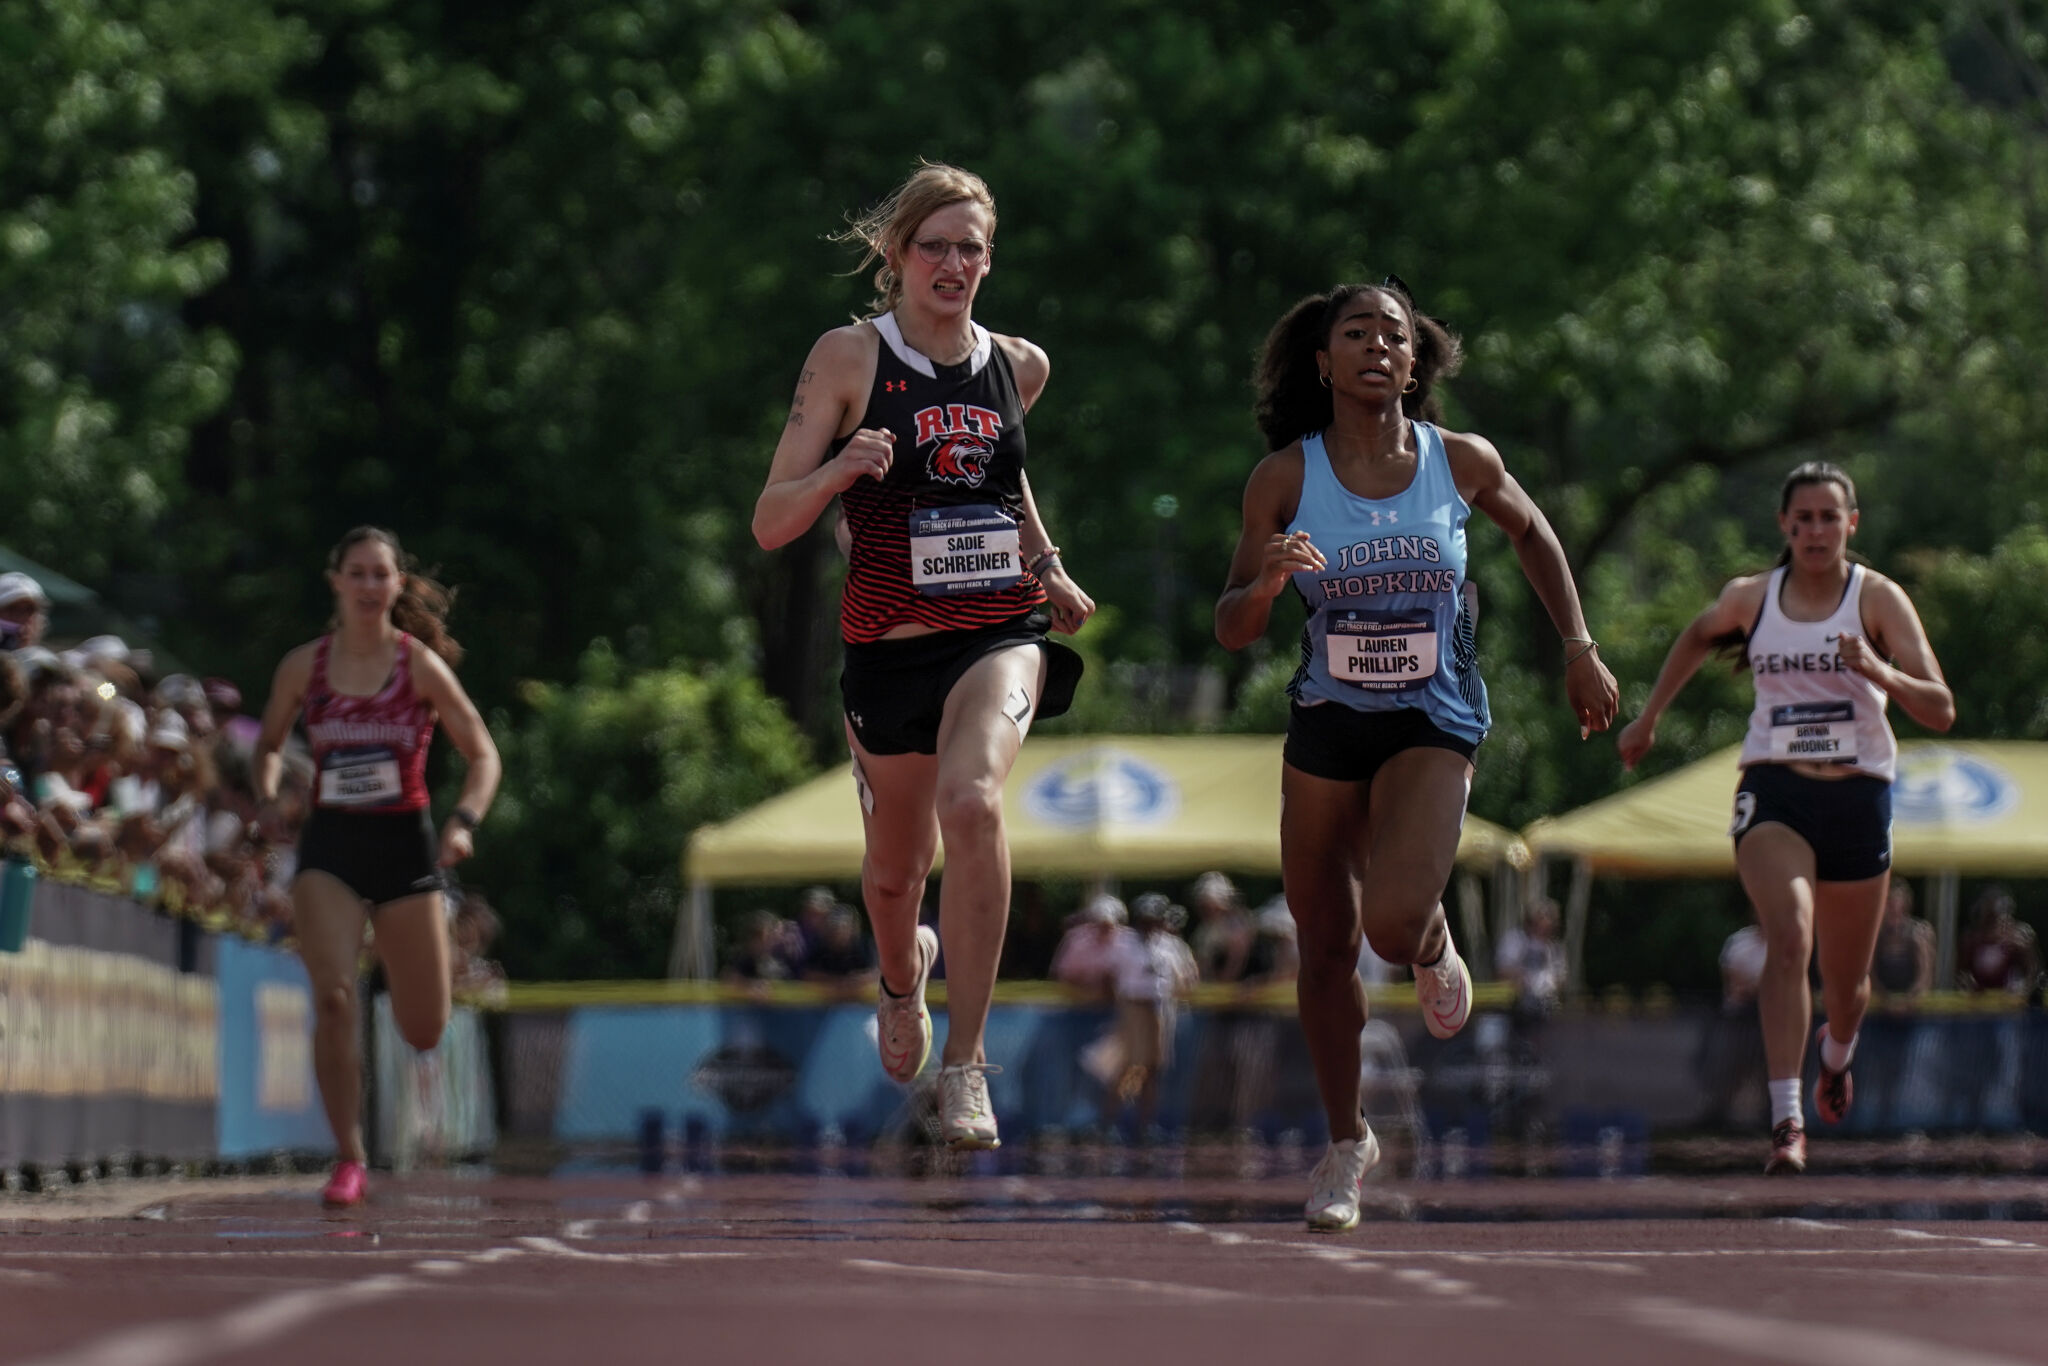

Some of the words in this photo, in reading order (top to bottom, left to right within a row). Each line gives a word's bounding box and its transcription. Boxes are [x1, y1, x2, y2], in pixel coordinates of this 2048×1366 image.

[914, 404, 1003, 448] RIT
[947, 535, 985, 552] SADIE
[1338, 535, 1440, 572] JOHNS
[922, 552, 1011, 576] SCHREINER
[1319, 569, 1456, 600] HOPKINS
[1356, 638, 1408, 653] LAUREN
[1348, 654, 1419, 673] PHILLIPS
[1752, 653, 1848, 674] GENESE
[1788, 738, 1840, 753] MOONEY
